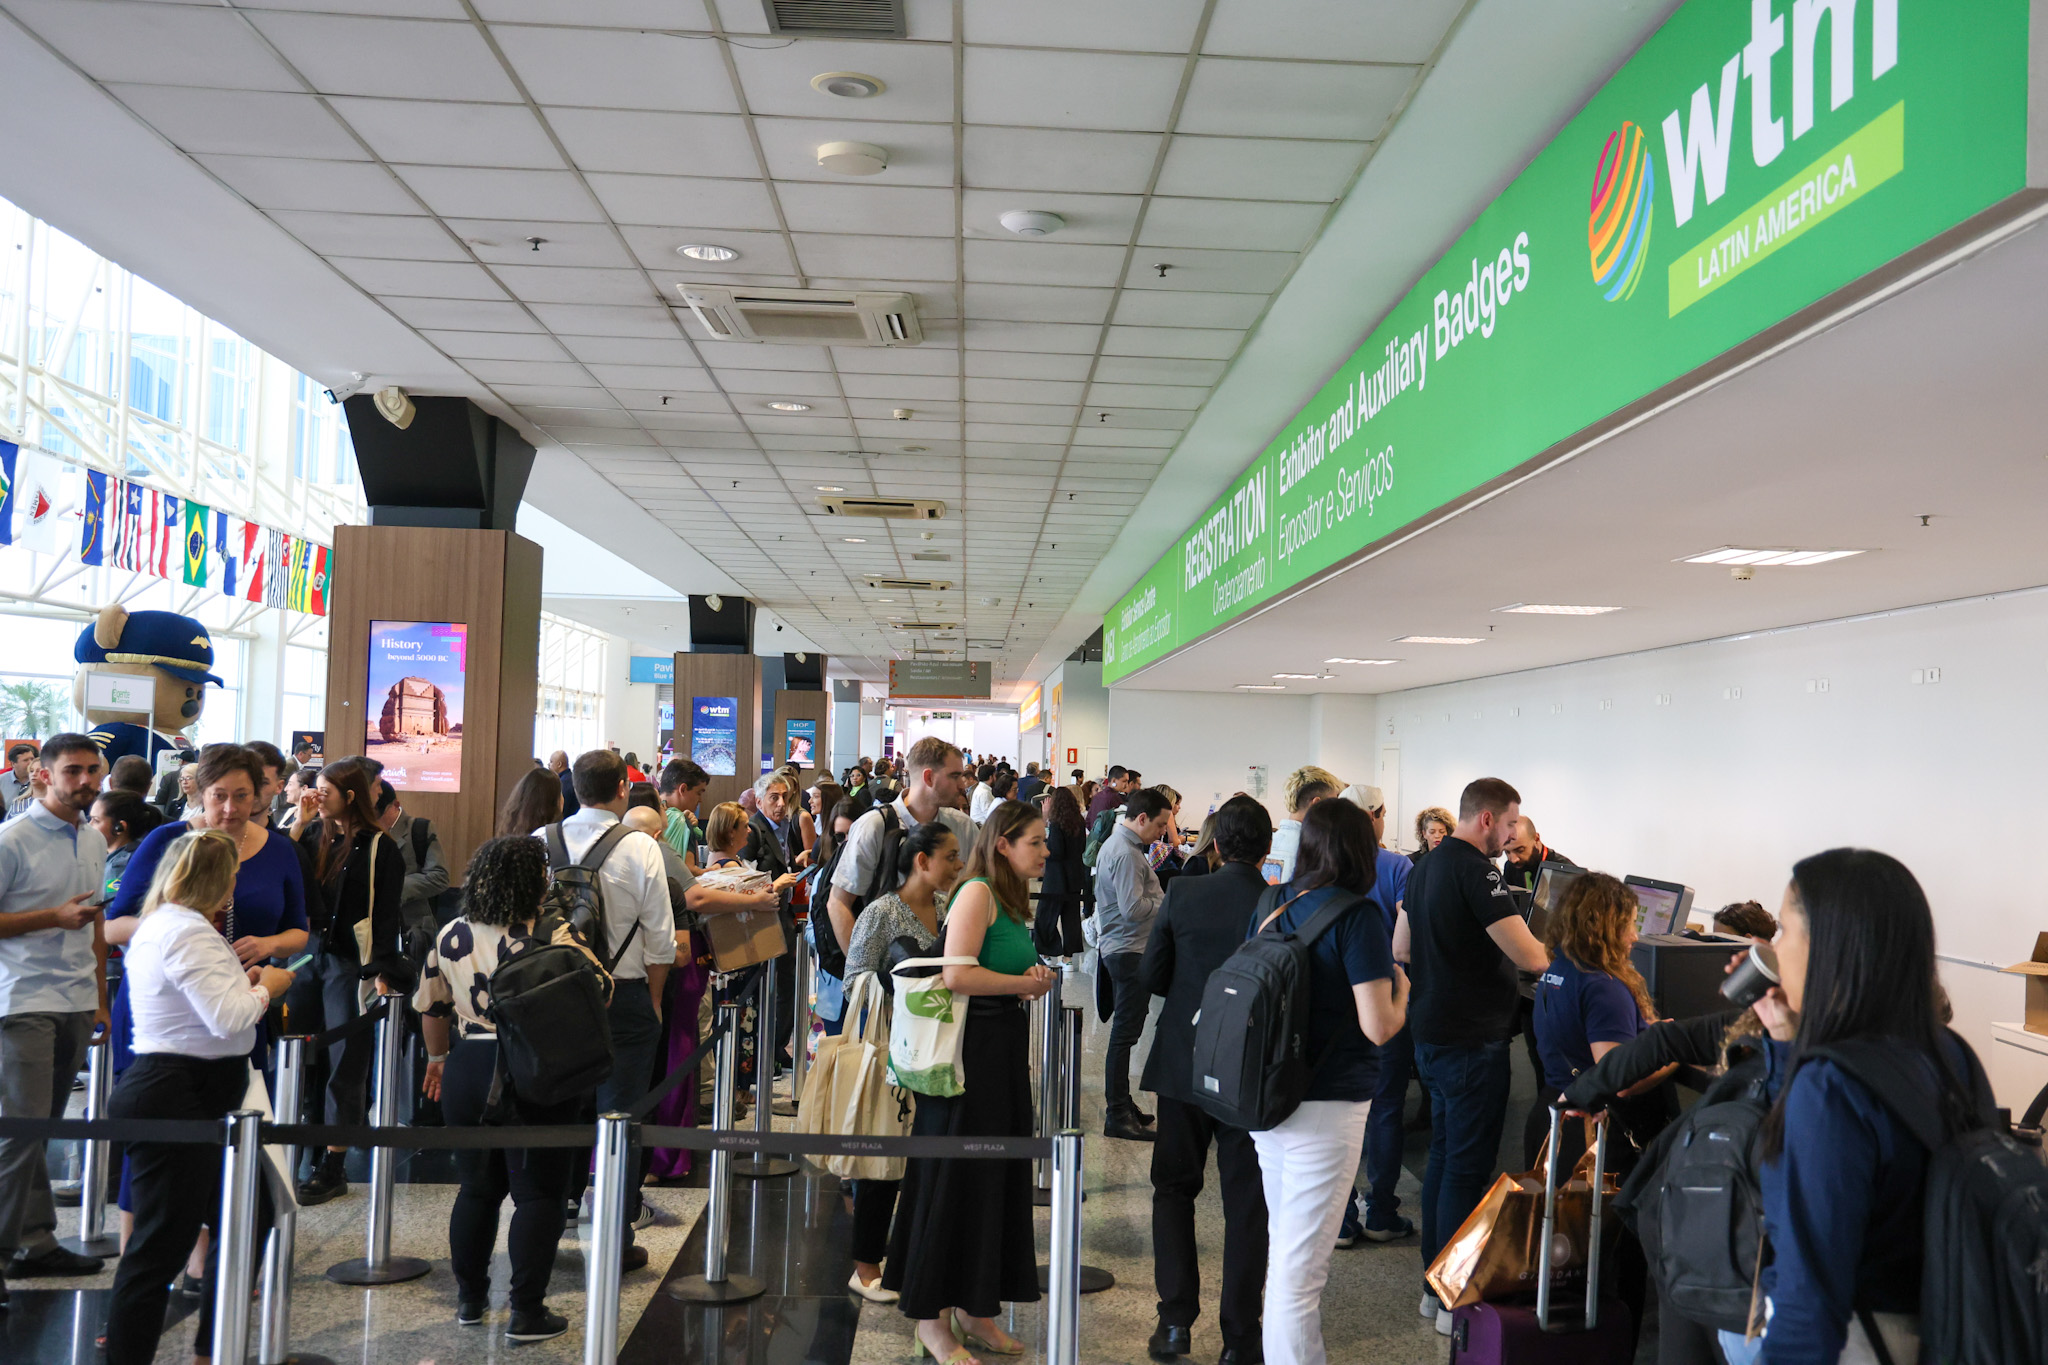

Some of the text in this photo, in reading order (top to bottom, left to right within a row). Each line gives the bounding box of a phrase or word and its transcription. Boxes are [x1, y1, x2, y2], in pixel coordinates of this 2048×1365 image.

[1662, 0, 1898, 228] wtm
[1698, 153, 1857, 288] LATIN AMERICA
[1279, 231, 1530, 496] Exhibitor and Auxiliary Badges
[1185, 465, 1266, 592] REGISTRATION
[1278, 444, 1394, 565] Expositor e Serviços
[1212, 551, 1266, 616] Credenciamento
[381, 638, 423, 652] History
[387, 653, 449, 663] beyond 5000 BC
[1104, 626, 1116, 667] CAEX
[718, 1136, 760, 1146] WEST PLAZA
[841, 1141, 883, 1150] WEST PLAZA
[963, 1143, 1005, 1151] WEST PLAZA
